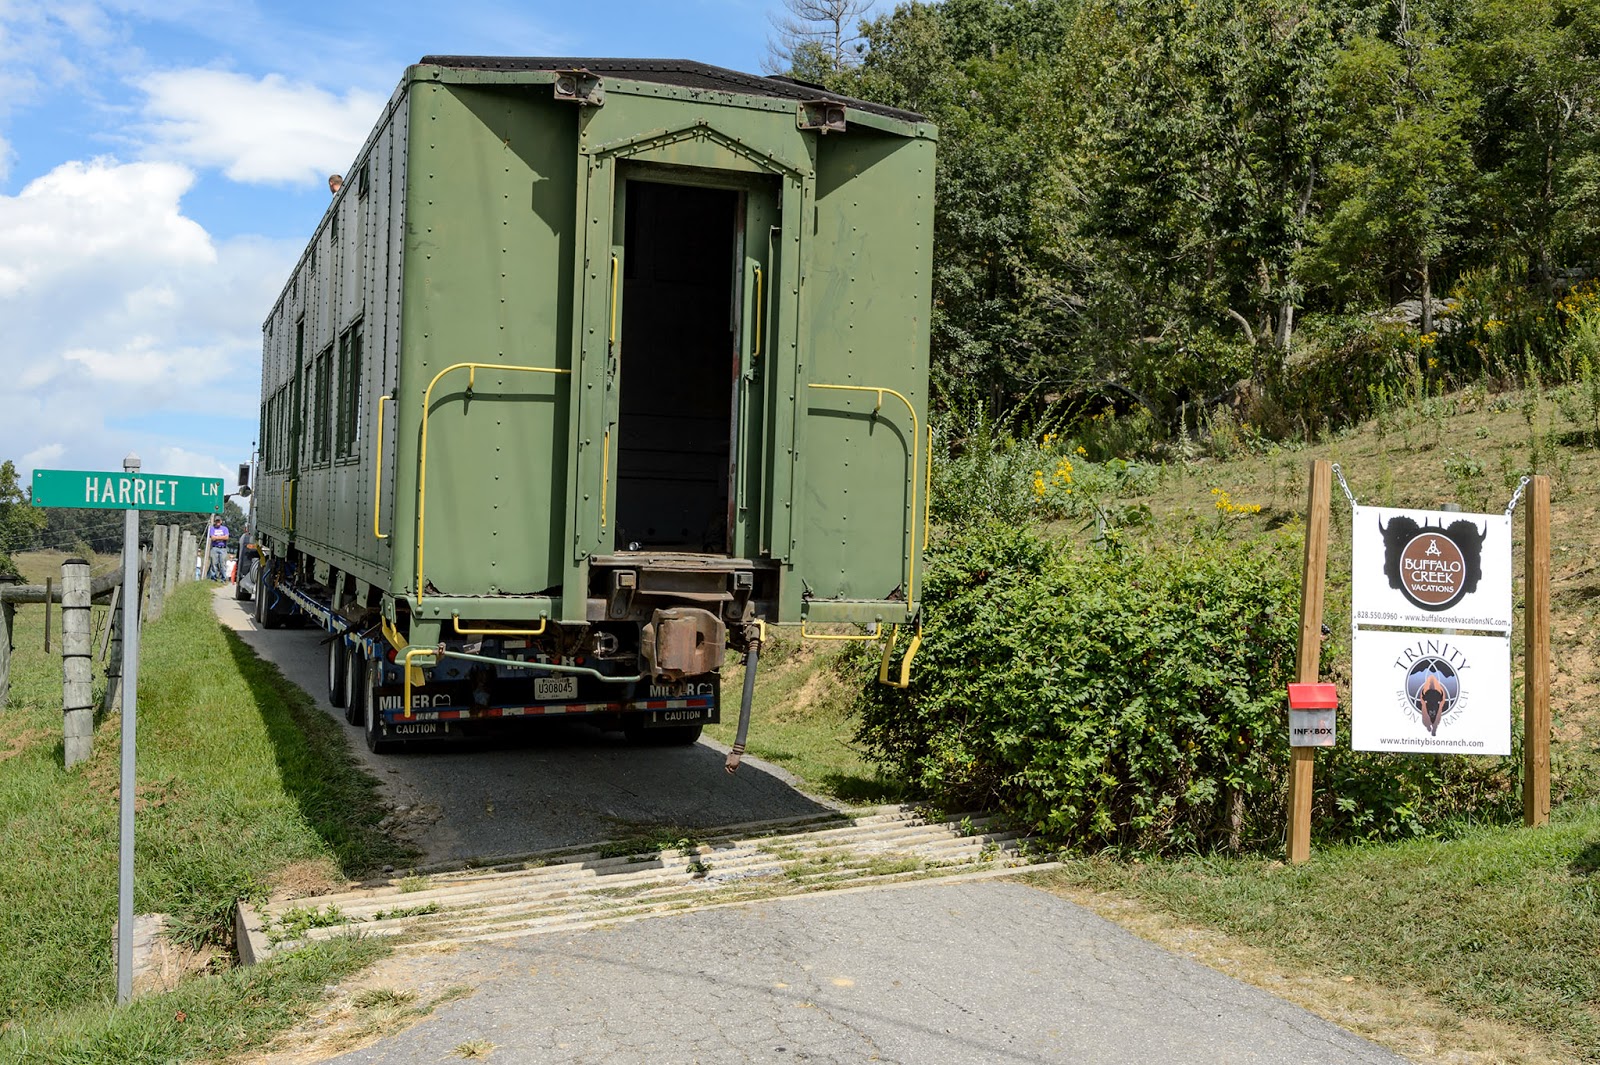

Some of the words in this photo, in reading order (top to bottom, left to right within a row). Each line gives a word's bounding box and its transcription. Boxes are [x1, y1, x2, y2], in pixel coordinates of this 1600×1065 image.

[85, 476, 179, 506] HARRIET
[201, 482, 218, 496] LN
[1404, 558, 1461, 573] BUFFALO
[1411, 570, 1454, 584] CREEK
[1411, 583, 1454, 593] VACATIONS
[1357, 610, 1398, 620] 828.550.0960
[1405, 613, 1507, 626] www.buffalocreekvacationsNC.com
[1393, 639, 1471, 672] TRINITY
[538, 682, 573, 694] U308045
[378, 694, 430, 711] MILER
[1396, 690, 1420, 724] BISON
[1442, 690, 1469, 728] RANCH
[664, 710, 701, 721] CAUTION
[395, 723, 436, 734] CAUTION
[1380, 736, 1484, 748] www.trinitybisonranch.com
